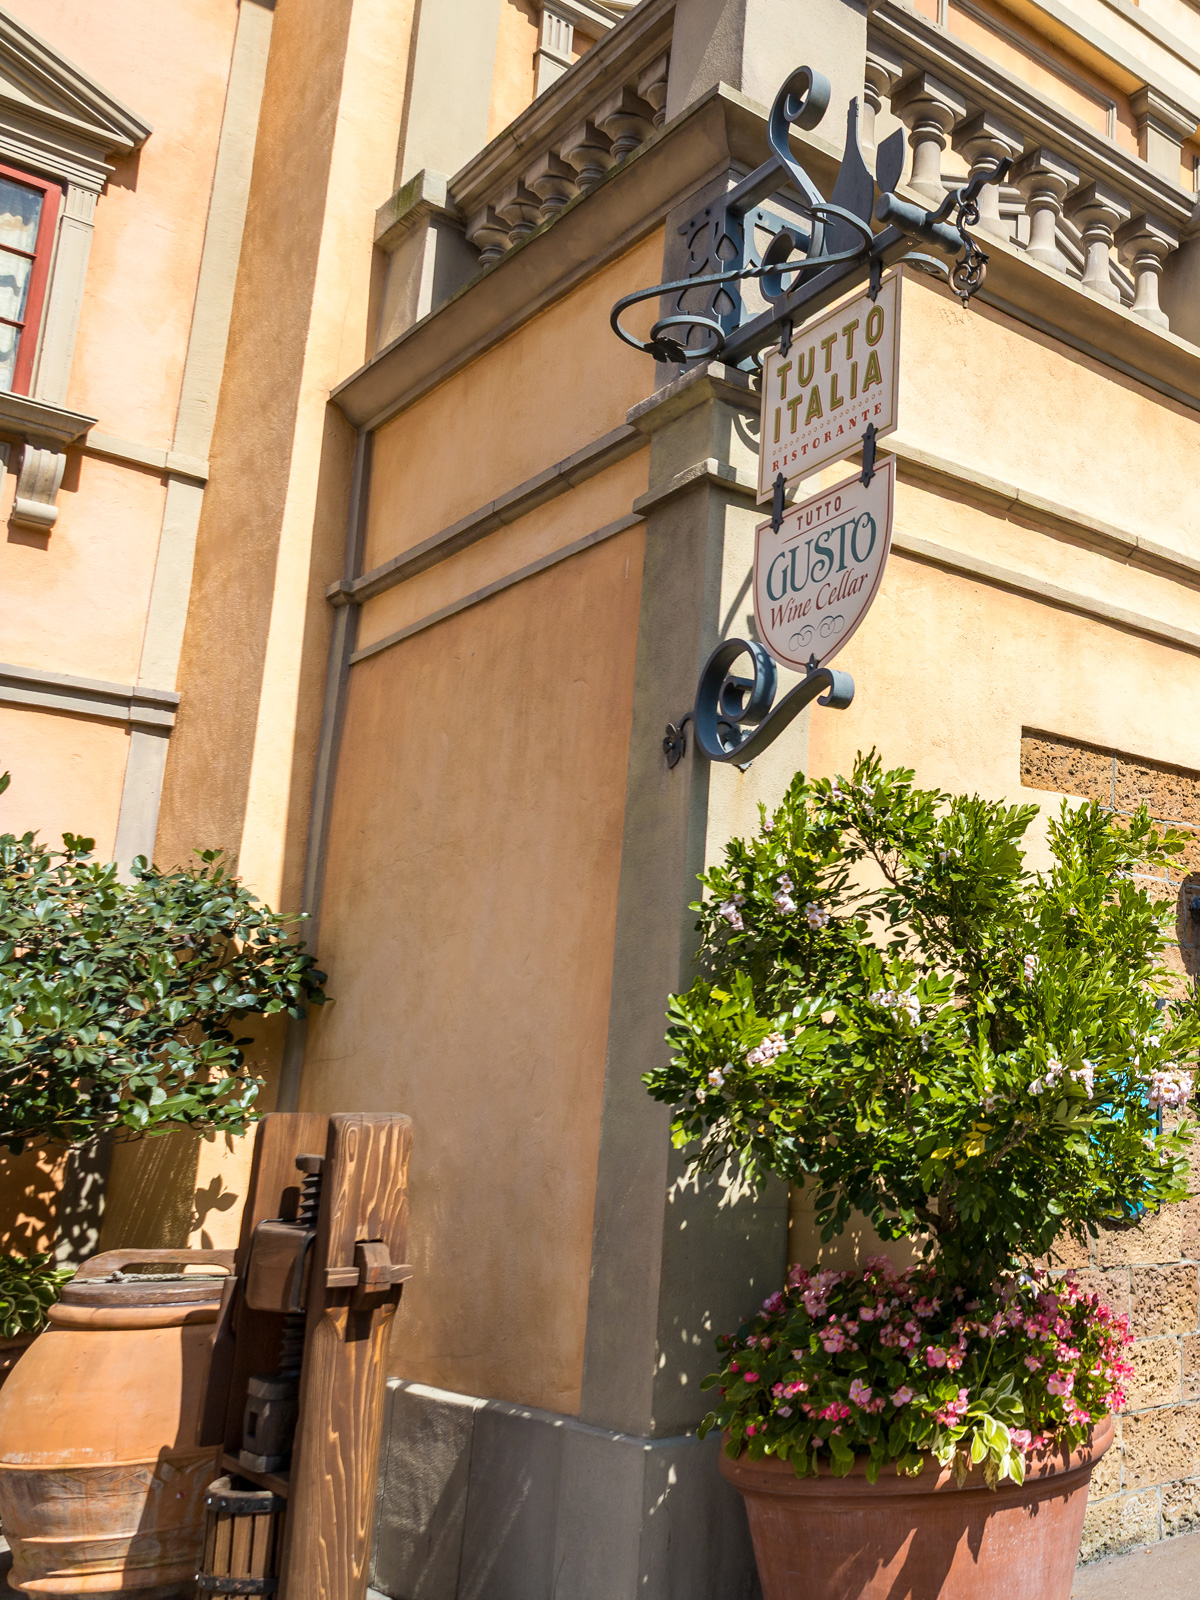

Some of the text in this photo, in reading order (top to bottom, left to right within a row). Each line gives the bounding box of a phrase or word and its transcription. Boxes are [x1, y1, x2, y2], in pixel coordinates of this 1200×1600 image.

[777, 305, 884, 400] TUTTO
[774, 349, 883, 444] ITALIA
[772, 402, 882, 472] RISTORANTE
[797, 496, 842, 531] TUTTO
[766, 511, 877, 602] GUSTO
[770, 568, 868, 631] Wine Cellar
